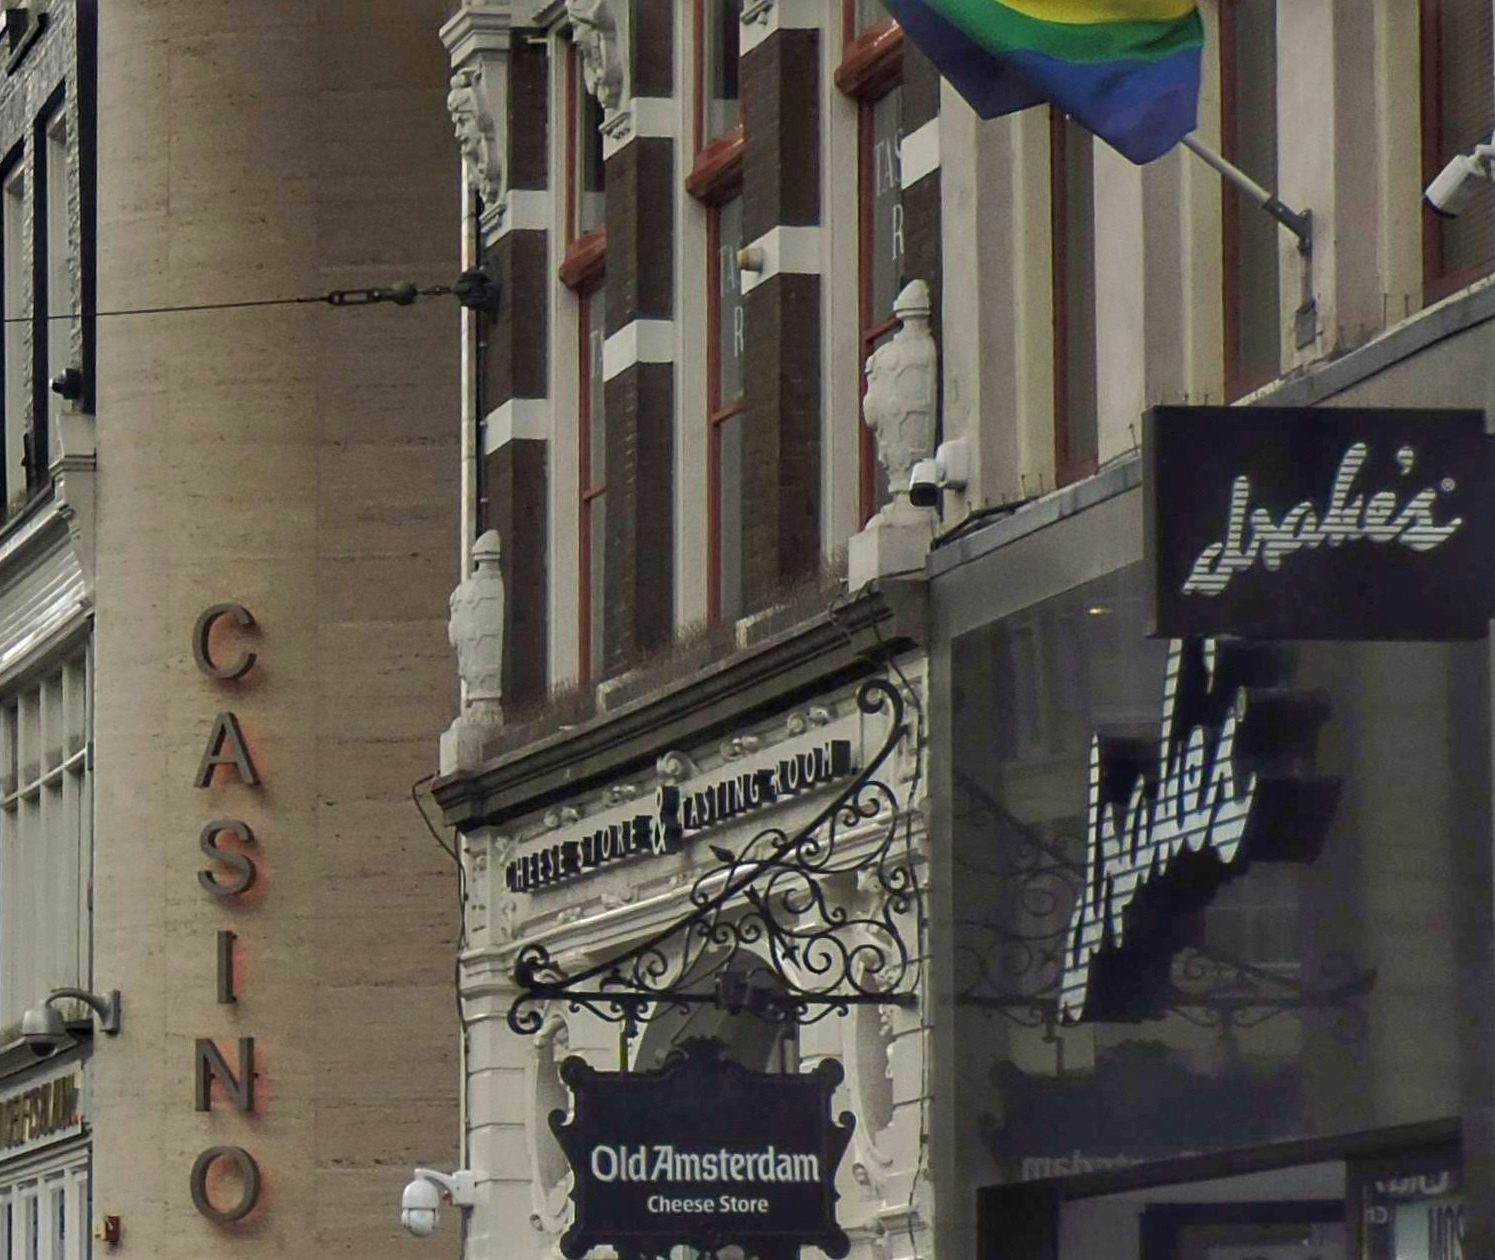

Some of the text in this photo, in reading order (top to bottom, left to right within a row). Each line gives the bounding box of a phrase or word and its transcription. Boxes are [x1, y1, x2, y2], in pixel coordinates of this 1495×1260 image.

[504, 741, 833, 890] CHEESE STORE & TASTING ROOM
[189, 602, 262, 1224] CASINO
[591, 1145, 820, 1182] Old Amsterdam
[647, 1195, 769, 1213] Cheese Store
